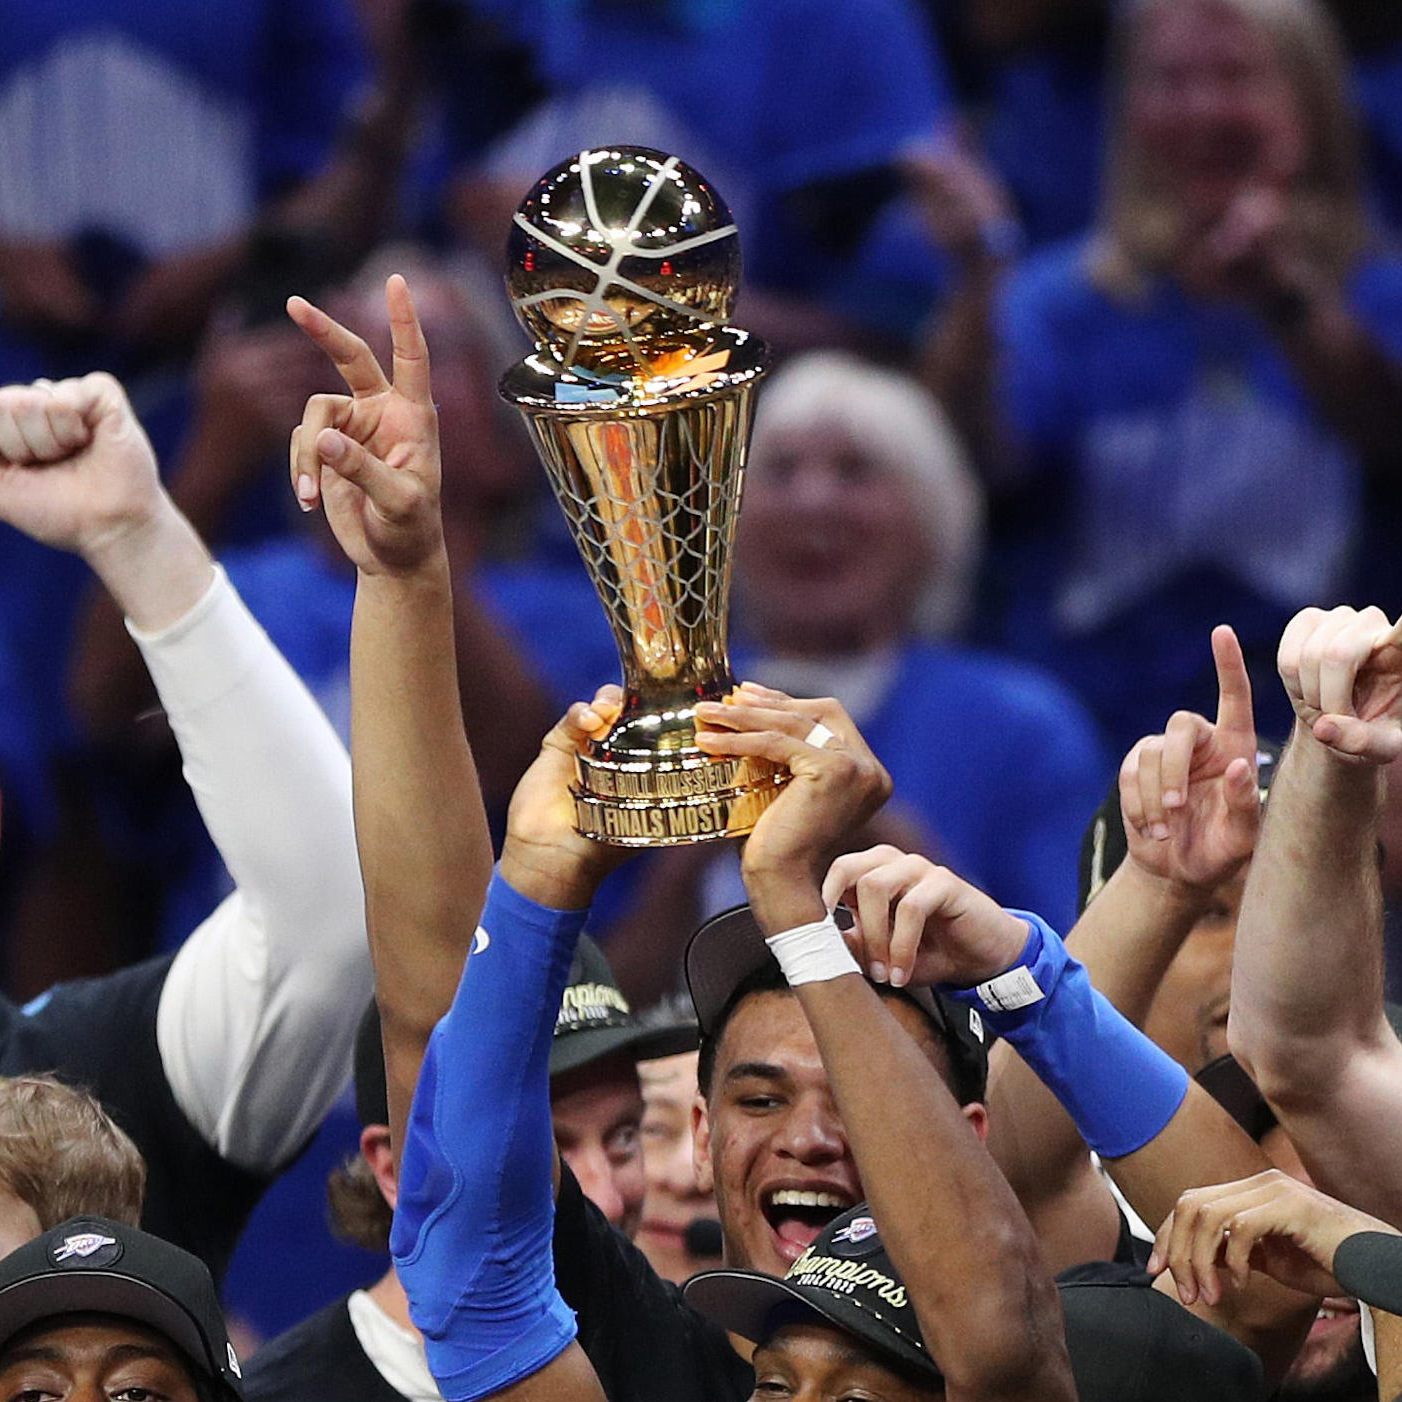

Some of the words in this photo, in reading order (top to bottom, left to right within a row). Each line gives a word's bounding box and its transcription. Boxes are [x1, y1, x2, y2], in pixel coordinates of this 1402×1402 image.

[615, 773, 653, 799] BILL
[655, 763, 733, 799] RUSSELL
[604, 807, 665, 837] FINALS
[668, 803, 722, 836] MOST
